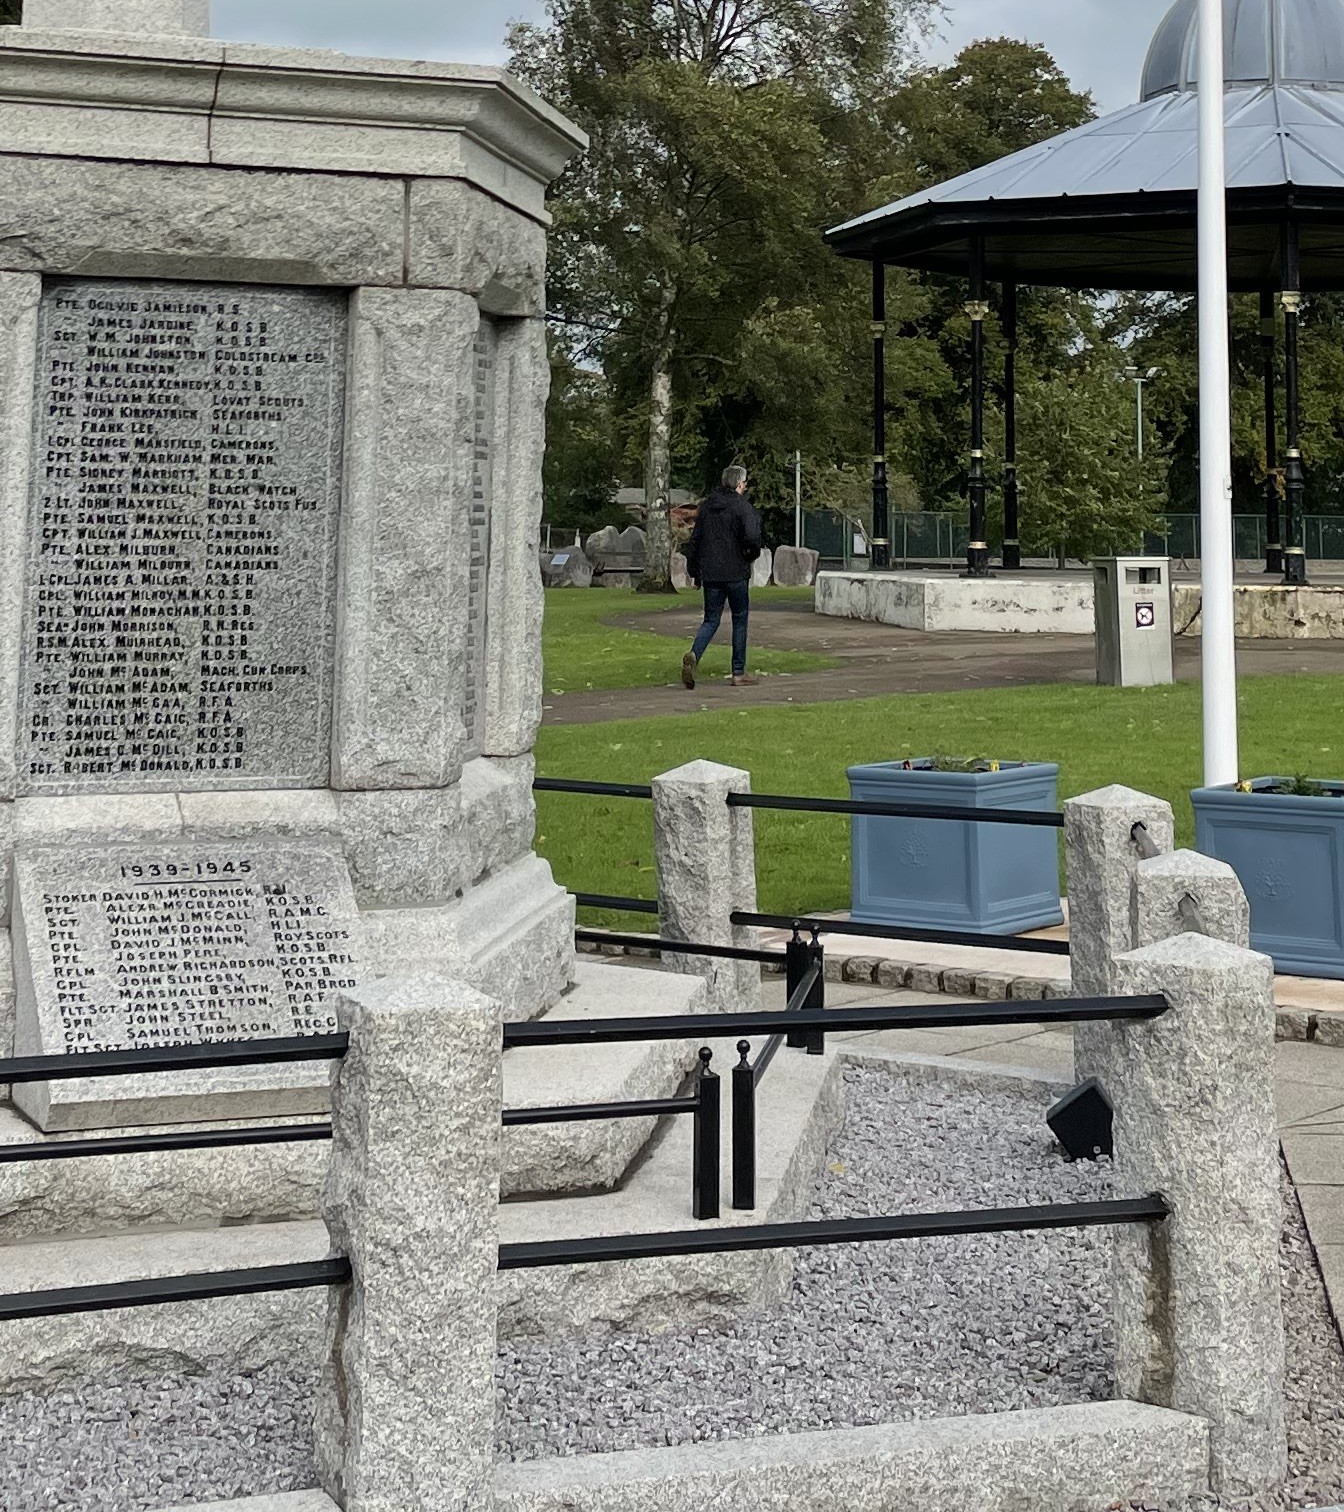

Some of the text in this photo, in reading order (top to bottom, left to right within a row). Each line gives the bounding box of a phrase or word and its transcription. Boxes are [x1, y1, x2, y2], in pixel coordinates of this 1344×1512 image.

[88, 316, 132, 328] JAMES
[87, 346, 139, 358] WILLIAM
[86, 361, 119, 373] JOHN
[115, 377, 155, 389] CLARK
[85, 392, 141, 403] WILLIAM
[213, 395, 251, 406] LOVAT
[83, 406, 114, 417] JOHN
[81, 421, 125, 433] FRANK
[81, 436, 127, 448] GEORGE
[79, 467, 125, 478] SIDNEY
[78, 482, 123, 493] JAMES
[208, 483, 250, 495] BLACK
[78, 497, 111, 509] JOHN
[208, 497, 246, 510] ROYAL
[254, 499, 290, 511] SCOTS
[77, 512, 128, 525] SAMUEL
[77, 528, 126, 539] WILLIAM
[74, 559, 131, 570] WILLIAM
[74, 574, 118, 586] JAMES
[74, 590, 125, 601] WILLIAM
[73, 605, 126, 617] WILLIAM
[72, 620, 105, 633] JOHN
[70, 651, 127, 663] WILLIAM
[69, 666, 104, 678] JOHN
[243, 665, 267, 676] GUN
[68, 683, 125, 695] WILLIAM
[67, 698, 125, 710] WILLIAM
[67, 714, 126, 726] CHARLES
[65, 730, 117, 741] SAMUEL
[65, 745, 110, 758] JAMES
[64, 761, 113, 774] ROBERT
[120, 860, 252, 879] 1939-1945
[43, 892, 149, 903] STOKER DAVID
[107, 914, 171, 924] WILLIAM
[110, 927, 151, 937] JOHN
[111, 939, 160, 949] DAVID
[115, 951, 177, 961] JOSEPH
[117, 963, 178, 974] ANDREW
[119, 977, 162, 987] JOHN
[119, 987, 205, 999] MARSHALL
[123, 1001, 179, 1013] JAMES
[125, 1014, 169, 1025] JOHN
[126, 1026, 191, 1039] SAMUEL
